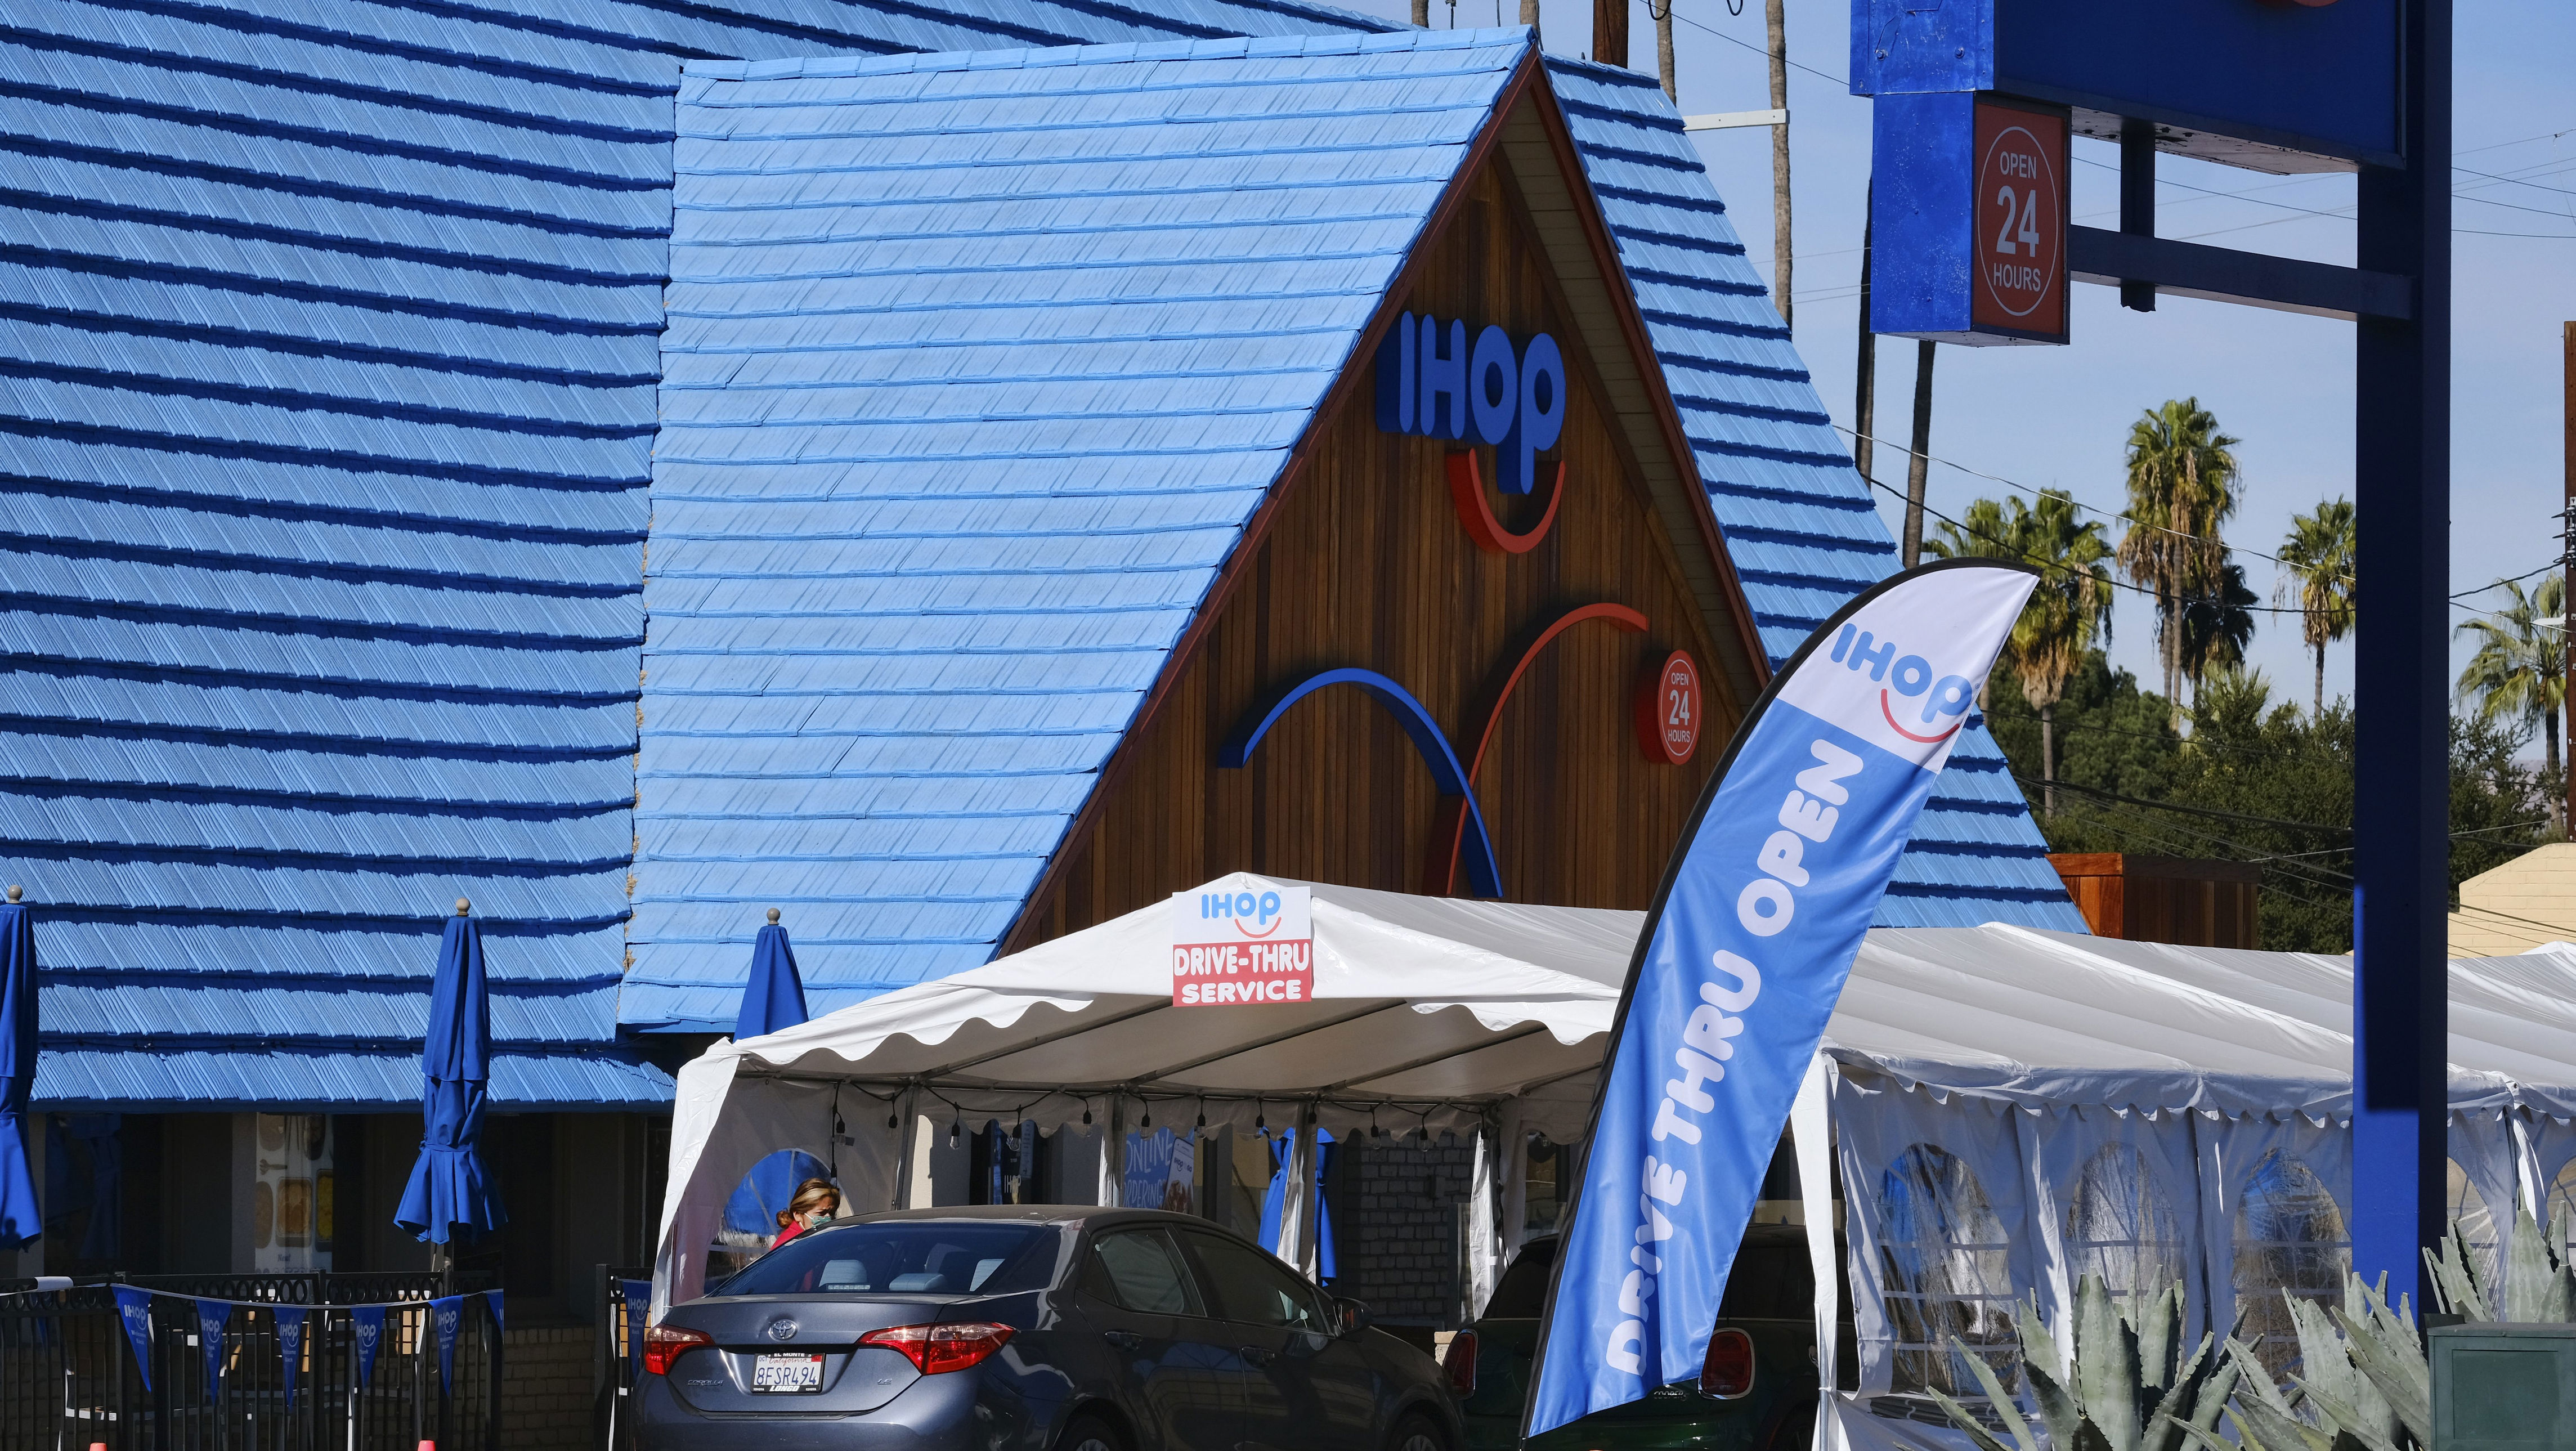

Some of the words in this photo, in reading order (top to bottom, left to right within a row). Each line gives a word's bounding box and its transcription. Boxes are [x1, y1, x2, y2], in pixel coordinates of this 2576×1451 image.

[2000, 151, 2036, 180] OPEN
[1996, 185, 2039, 257] 24
[1993, 262, 2040, 292] HOURS
[1671, 673, 1689, 686] OPEN
[1669, 689, 1690, 726] 24
[1668, 729, 1690, 743] HOURS
[1174, 943, 1309, 976] DRIVE-THRU
[1182, 979, 1301, 1004] SERVICE
[1606, 1155, 1687, 1377] DRIVE
[1651, 950, 1761, 1145] THRU
[1737, 739, 1863, 937] OPEN
[1123, 1179, 1164, 1208] RDERING
[756, 1367, 817, 1385] 8FSR494
